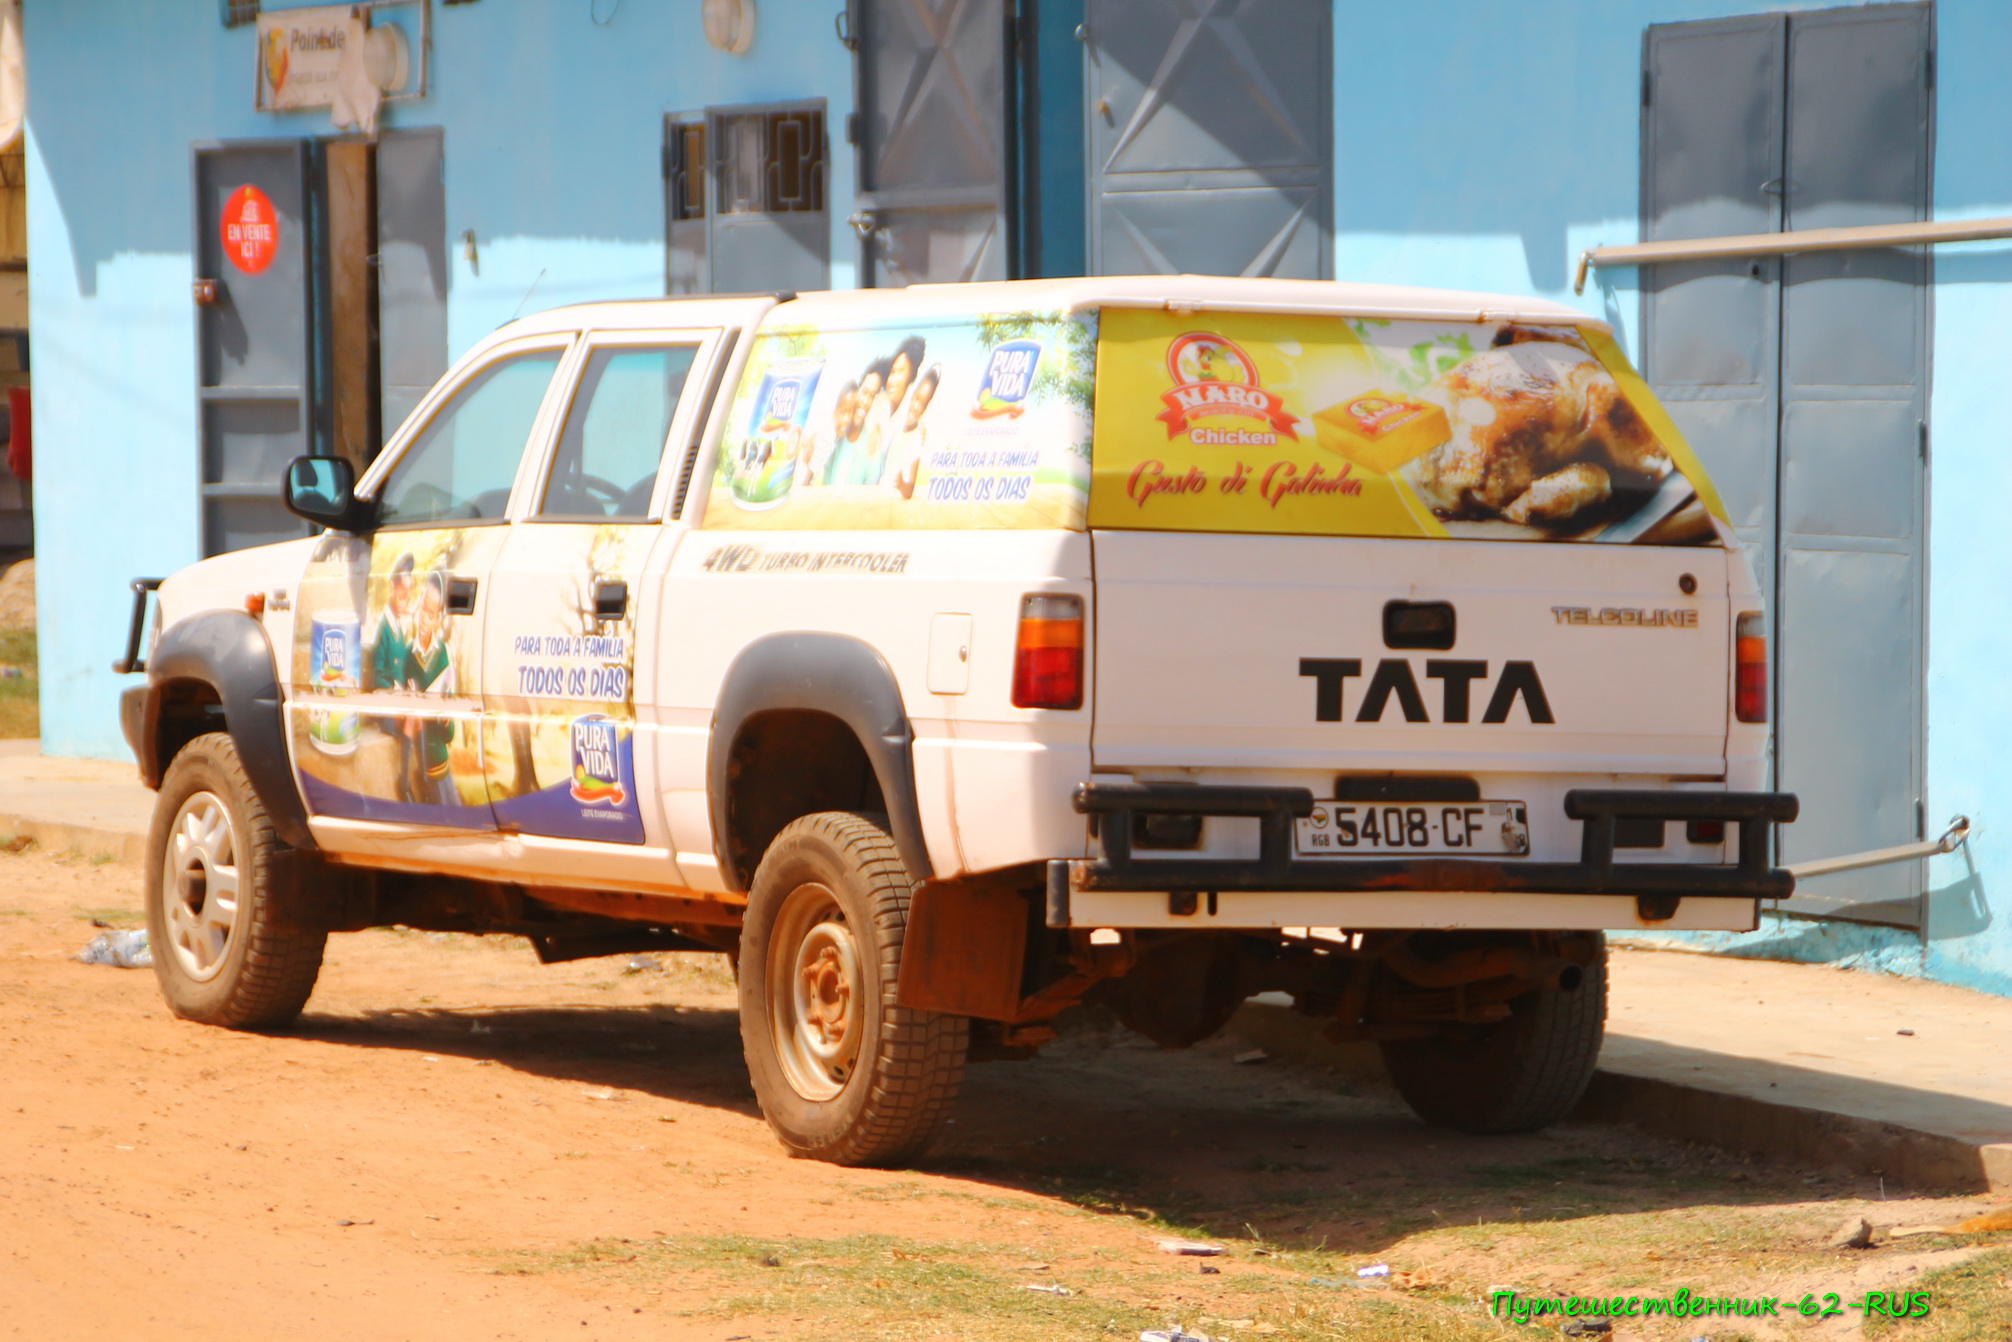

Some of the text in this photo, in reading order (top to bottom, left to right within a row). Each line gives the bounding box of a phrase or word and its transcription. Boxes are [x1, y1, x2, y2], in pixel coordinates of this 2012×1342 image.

[227, 224, 271, 241] EN VENTE
[990, 350, 1030, 376] PURA
[772, 386, 796, 404] PURA
[992, 370, 1025, 396] VIDA
[772, 400, 793, 418] VIDA
[1174, 385, 1270, 410] MARO
[1190, 427, 1278, 445] Chicken
[930, 451, 959, 468] PARA
[959, 451, 987, 468] TODA
[988, 451, 997, 467] A
[927, 475, 1032, 501] TODOS OS DIAS
[1126, 459, 1209, 510] Gusto
[702, 544, 909, 574] 4WD TURBO INTERCOOLER
[1551, 606, 1699, 628] TELCOLINE
[325, 636, 343, 654] PURA
[514, 635, 541, 656] PARA
[544, 636, 571, 657] TODA
[573, 637, 583, 657] A
[327, 651, 344, 669] VIDA
[518, 665, 625, 699] TODOS OS DIAS
[1299, 657, 1556, 724] TATA
[574, 722, 611, 752] PURA
[580, 746, 614, 778] VIDA
[1334, 806, 1484, 848] 5408-CF
[1311, 833, 1331, 847] RGB
